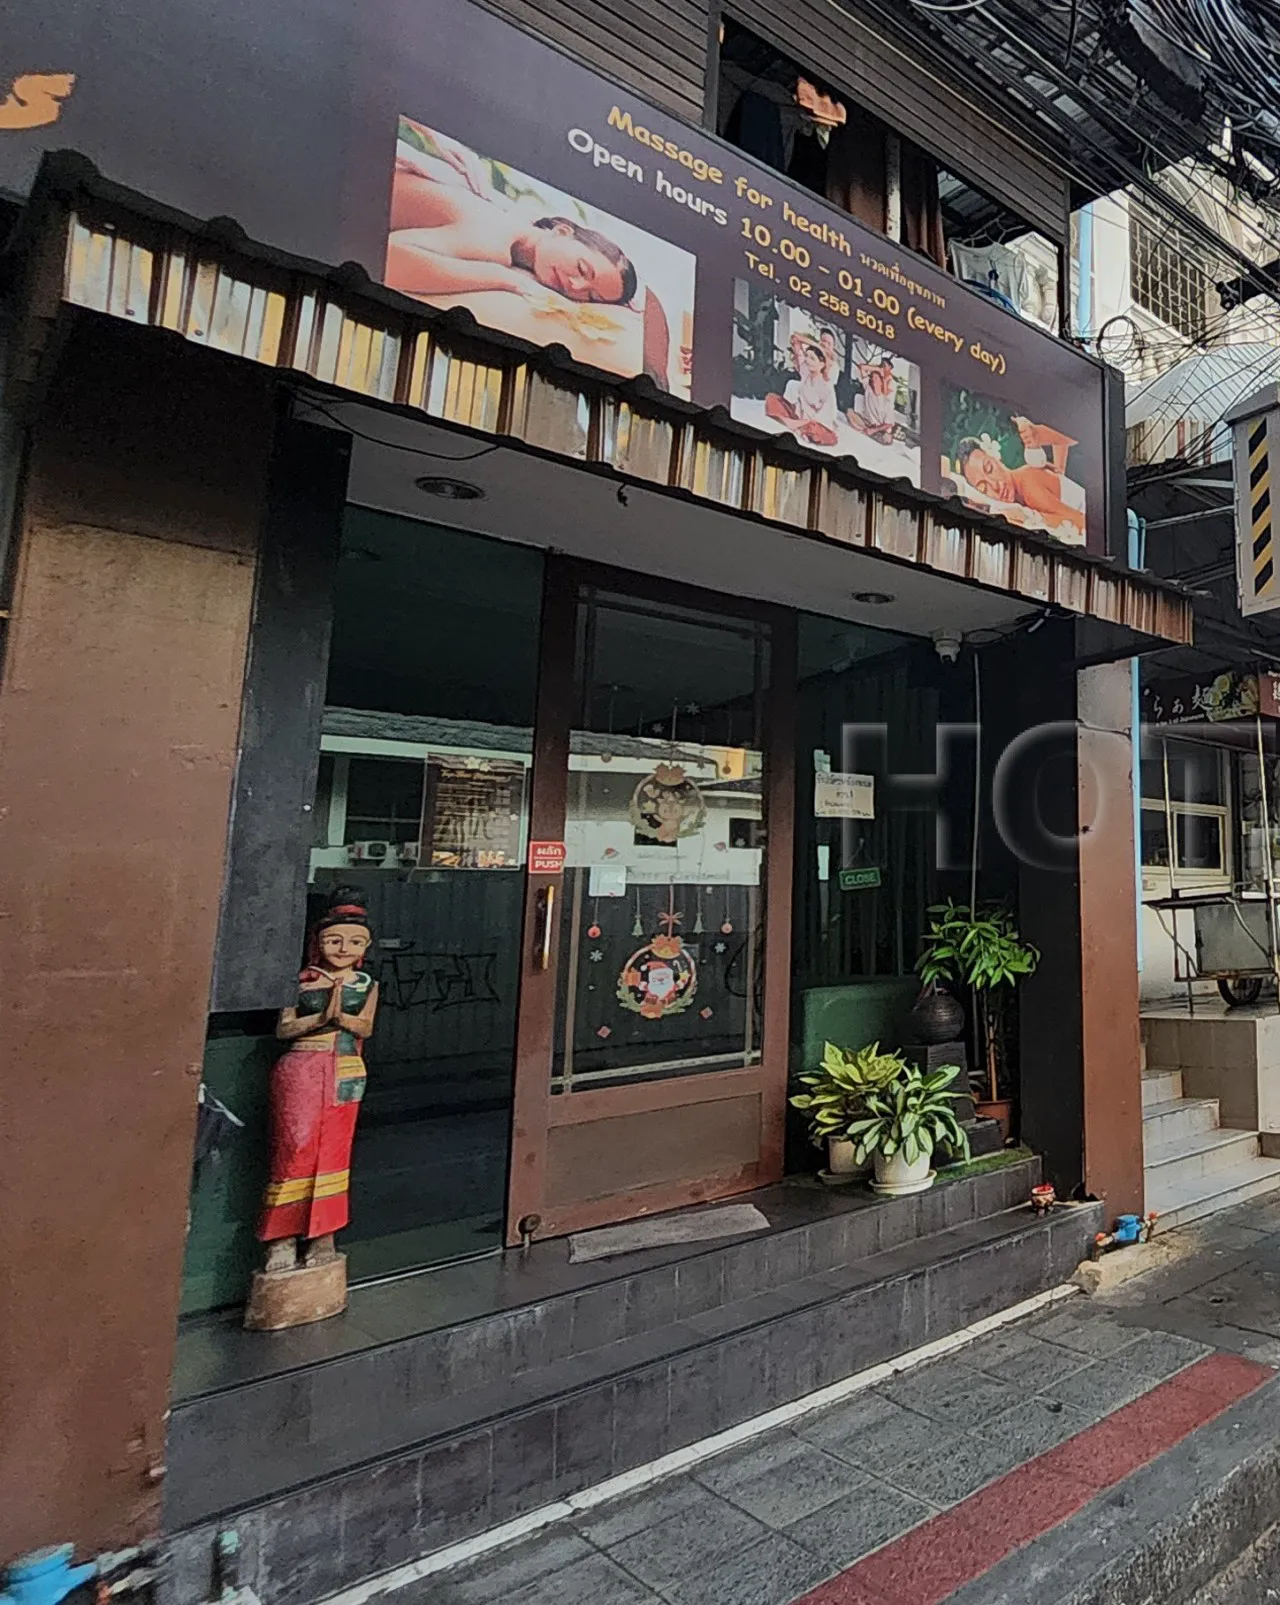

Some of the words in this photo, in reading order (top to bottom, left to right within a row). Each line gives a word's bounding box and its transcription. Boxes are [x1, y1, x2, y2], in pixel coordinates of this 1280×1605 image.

[606, 105, 724, 185] Massage
[733, 175, 774, 209] for
[783, 201, 852, 257] health
[567, 127, 644, 184] Open
[656, 169, 729, 226] hours
[740, 216, 811, 269] 10.00
[838, 269, 900, 316] 01.00
[907, 306, 965, 354] (every
[970, 341, 1007, 376] day)
[744, 250, 781, 285] Tel.
[788, 274, 812, 299] 02
[818, 290, 850, 318] 258
[855, 308, 896, 340] 5018
[535, 860, 563, 869] PUSH
[844, 873, 877, 886] CLOSE
